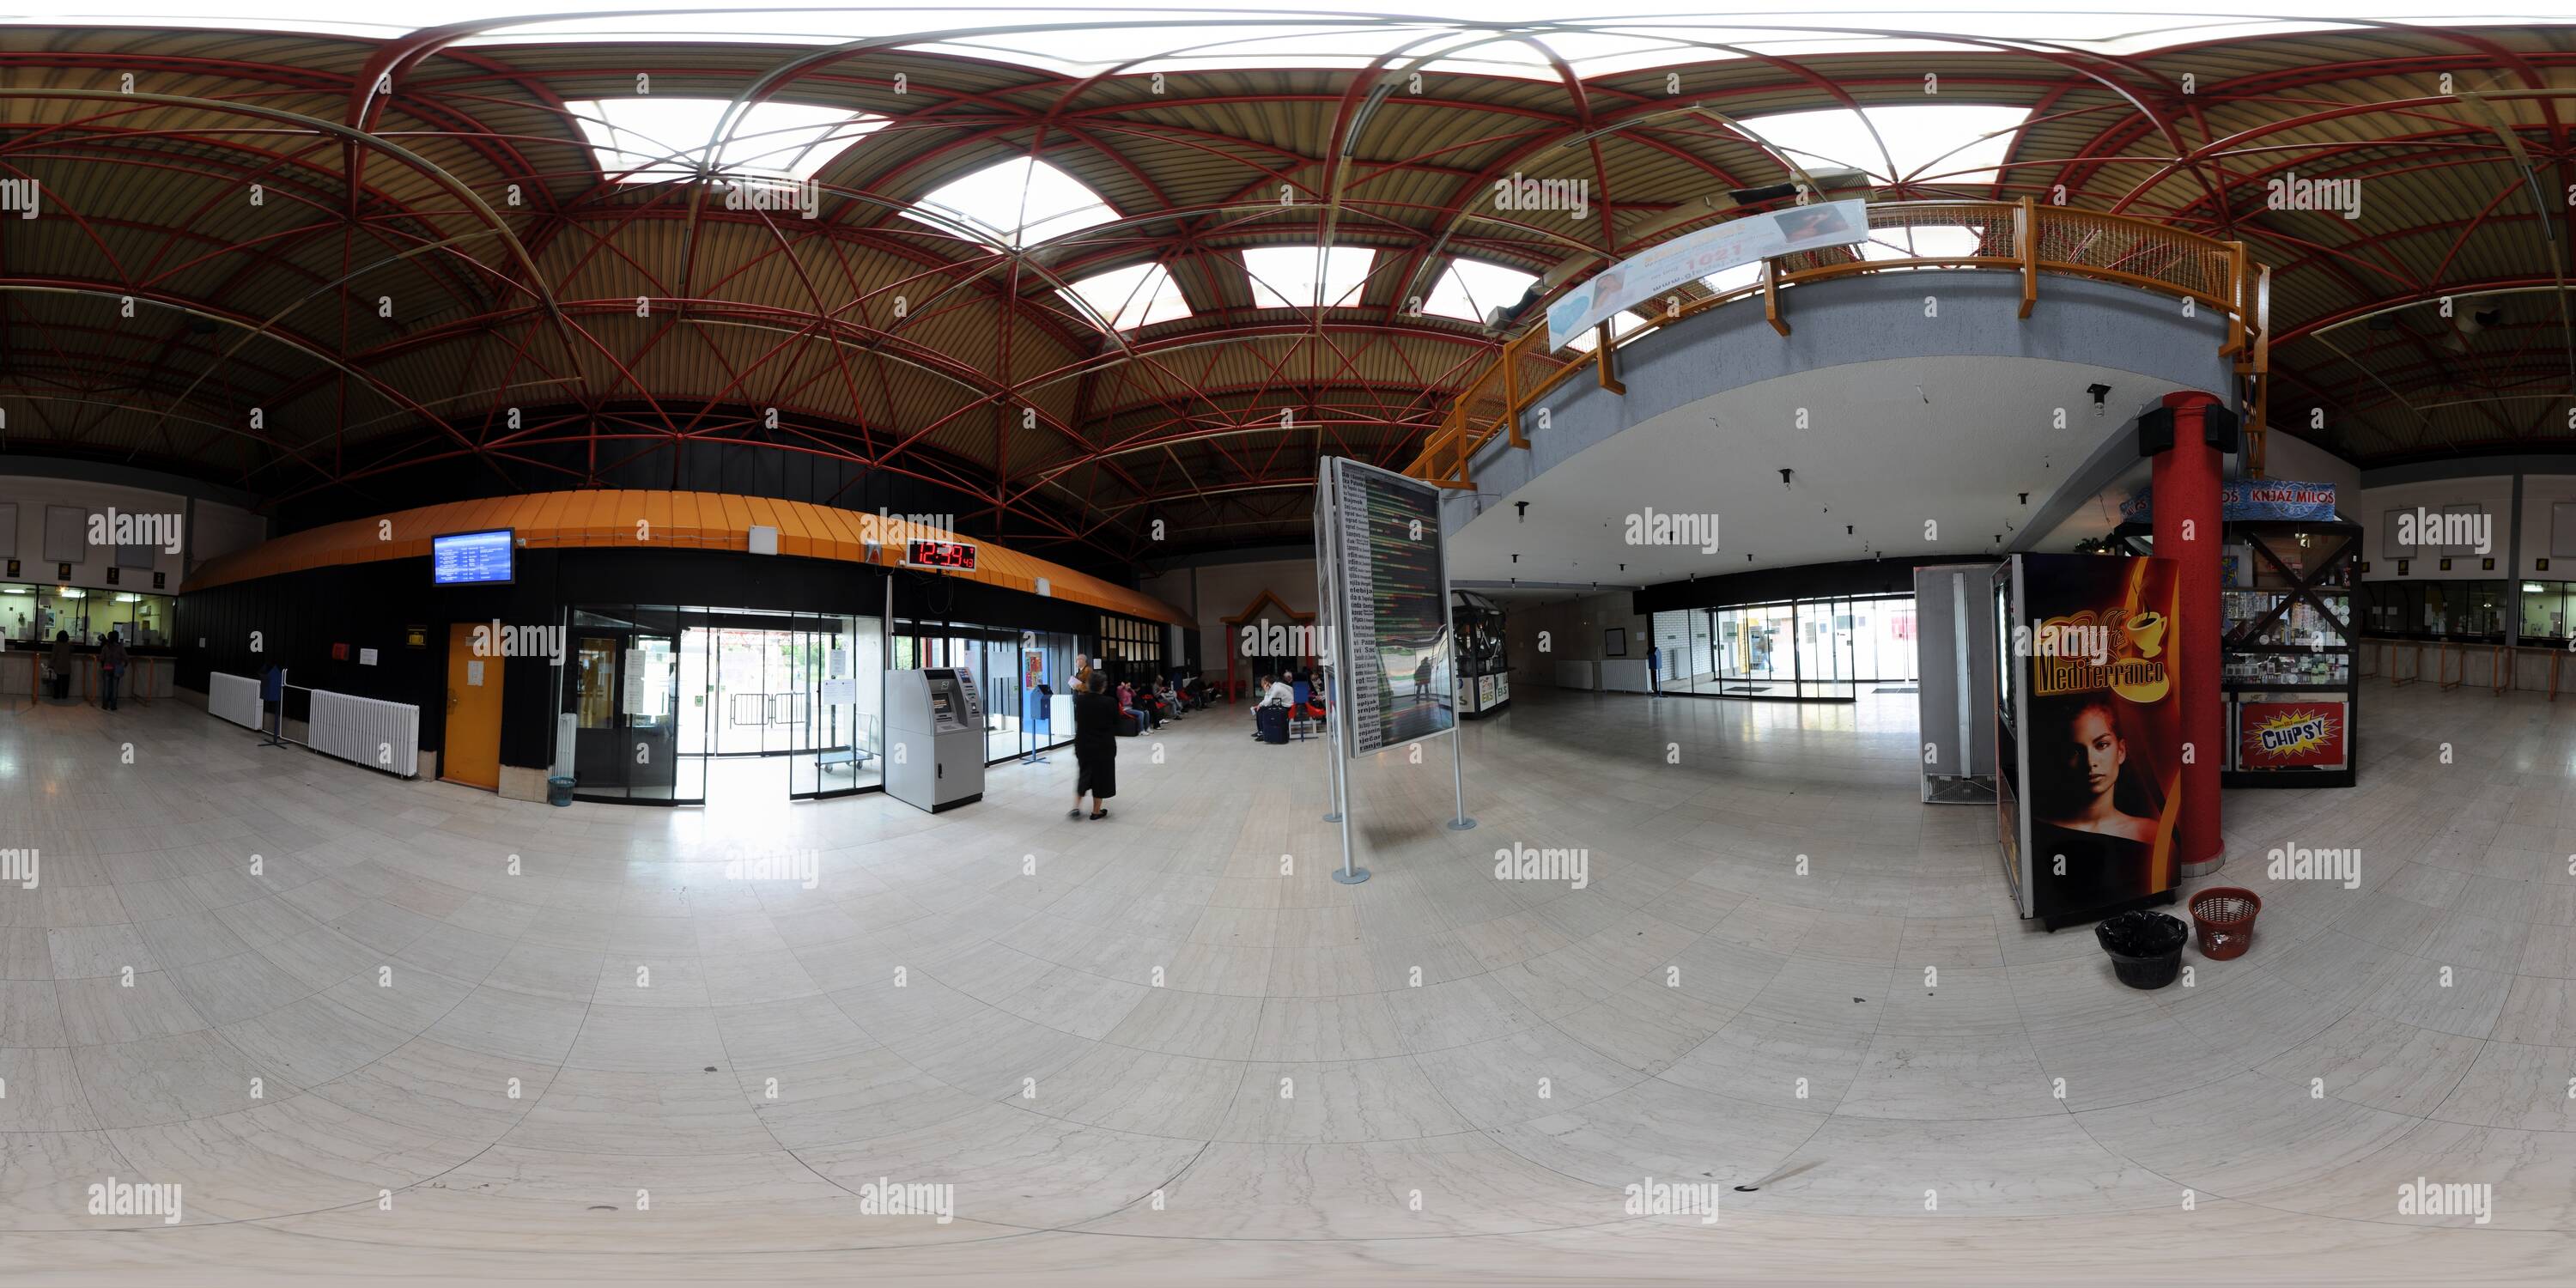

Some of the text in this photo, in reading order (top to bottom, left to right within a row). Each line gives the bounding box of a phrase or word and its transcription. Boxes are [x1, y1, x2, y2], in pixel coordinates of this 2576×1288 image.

[1685, 242, 1742, 271] 1021
[2252, 489, 2293, 502] KNJAZ
[2296, 488, 2335, 504] MILOŠ
[2039, 648, 2164, 693] Mediterraneo
[2262, 720, 2324, 750] CHIPSY
